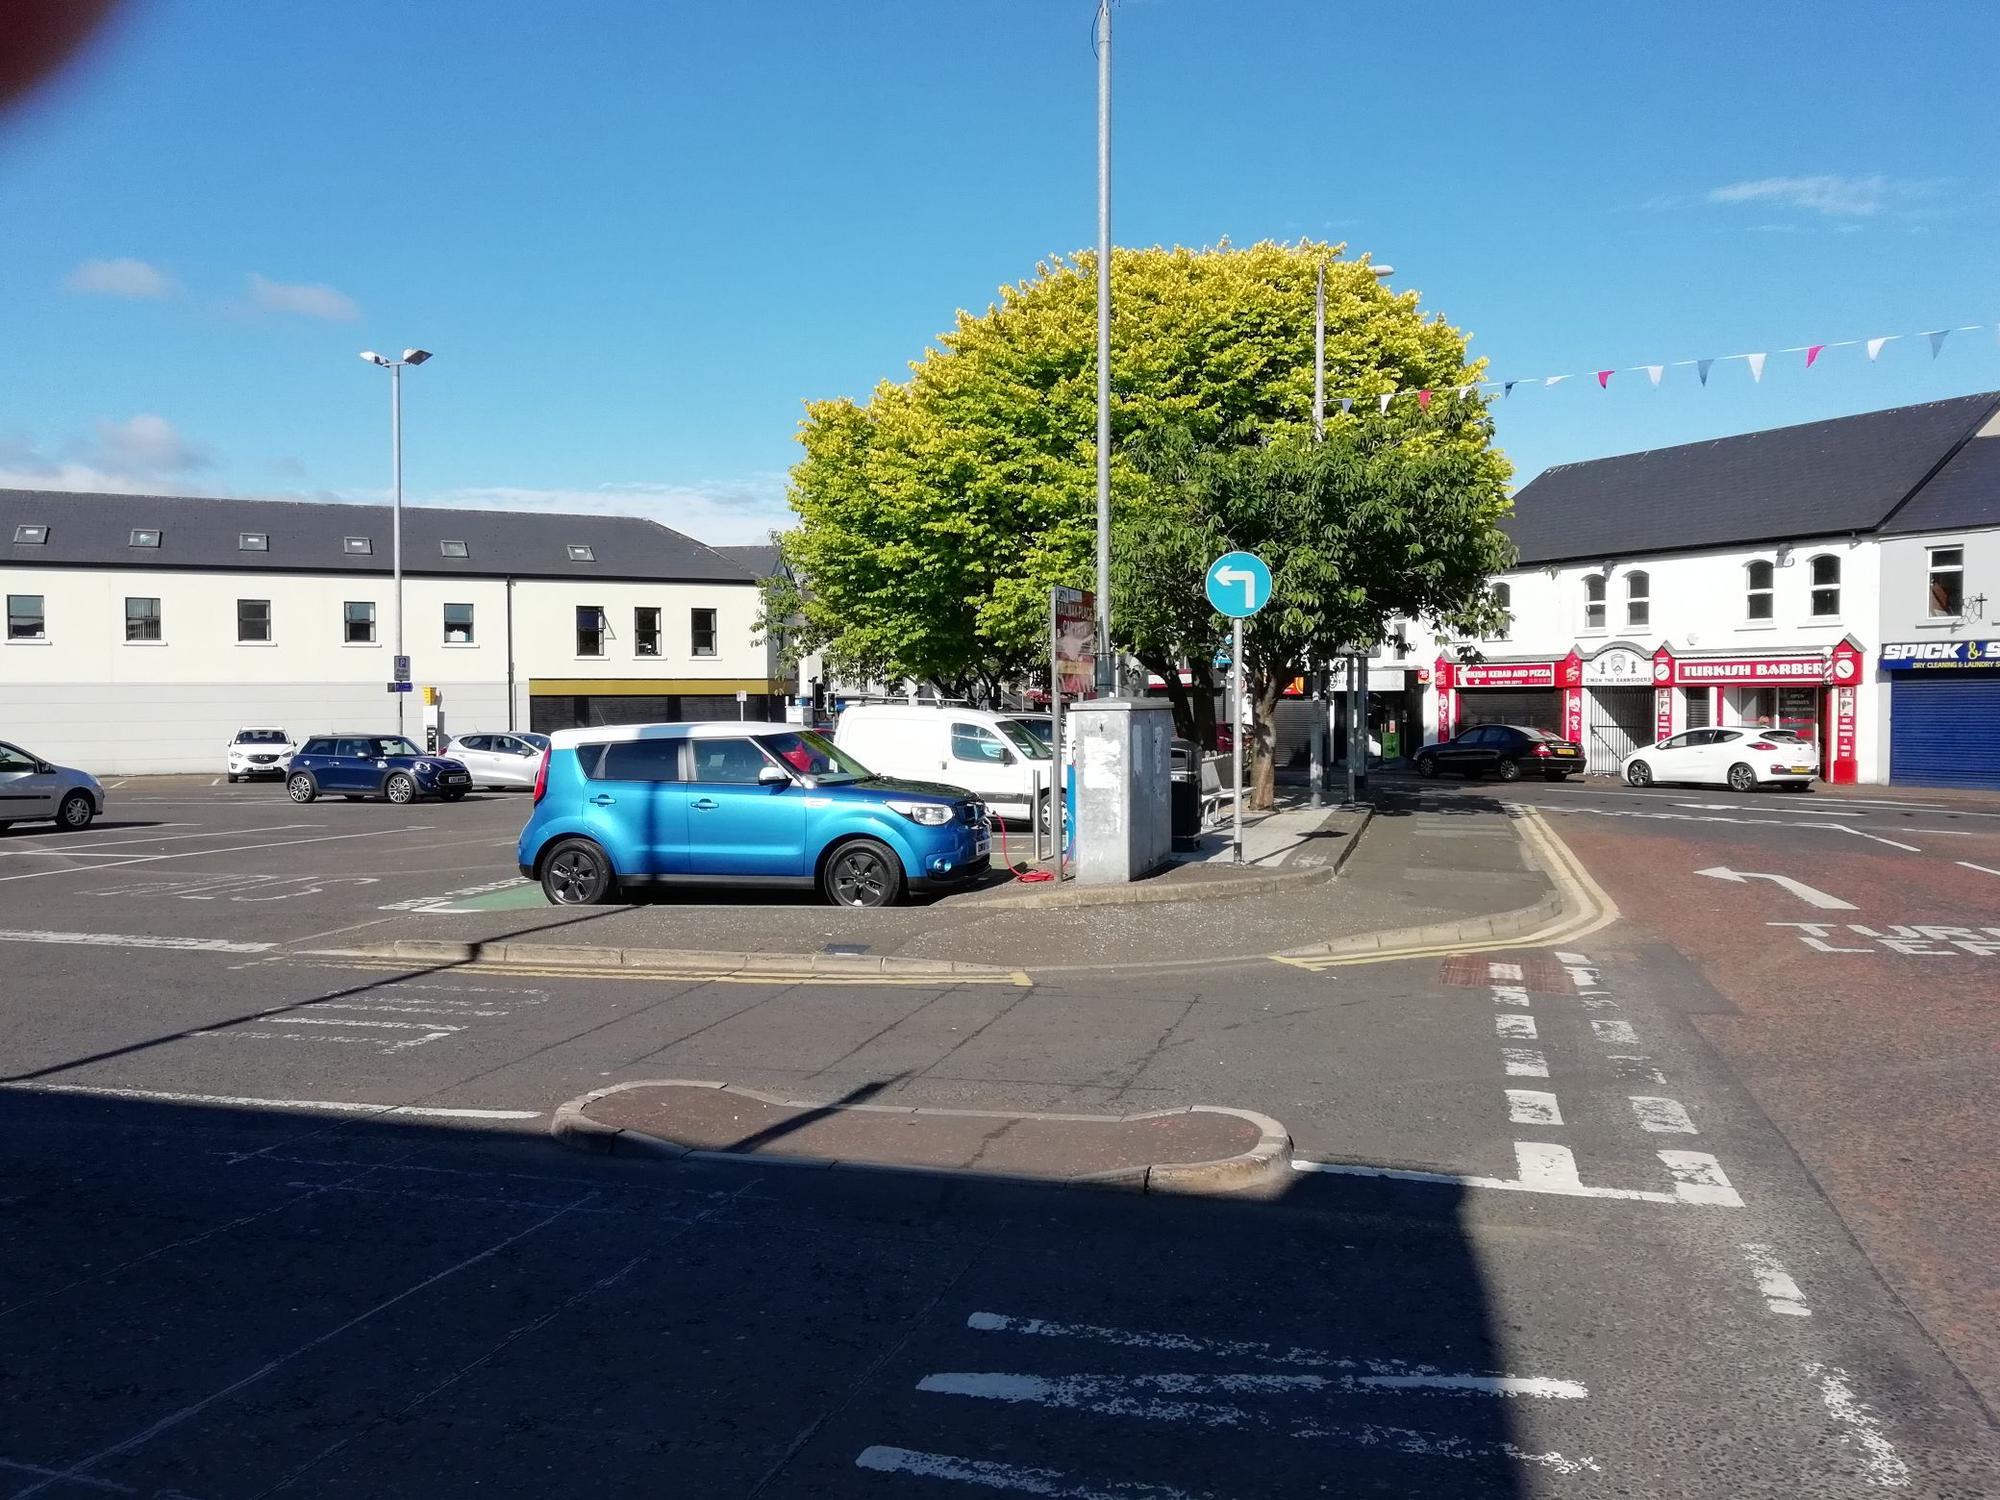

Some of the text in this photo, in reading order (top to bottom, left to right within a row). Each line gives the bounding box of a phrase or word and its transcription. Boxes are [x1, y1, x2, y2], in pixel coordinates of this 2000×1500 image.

[1884, 643, 1963, 660] SPICK
[1968, 641, 1982, 660] &
[1683, 664, 1751, 677] TURKISH
[1927, 661, 1957, 669] CLEANING
[1488, 670, 1512, 678] KEBAB
[1512, 670, 1529, 678] AND
[1529, 669, 1551, 677] PIZZA
